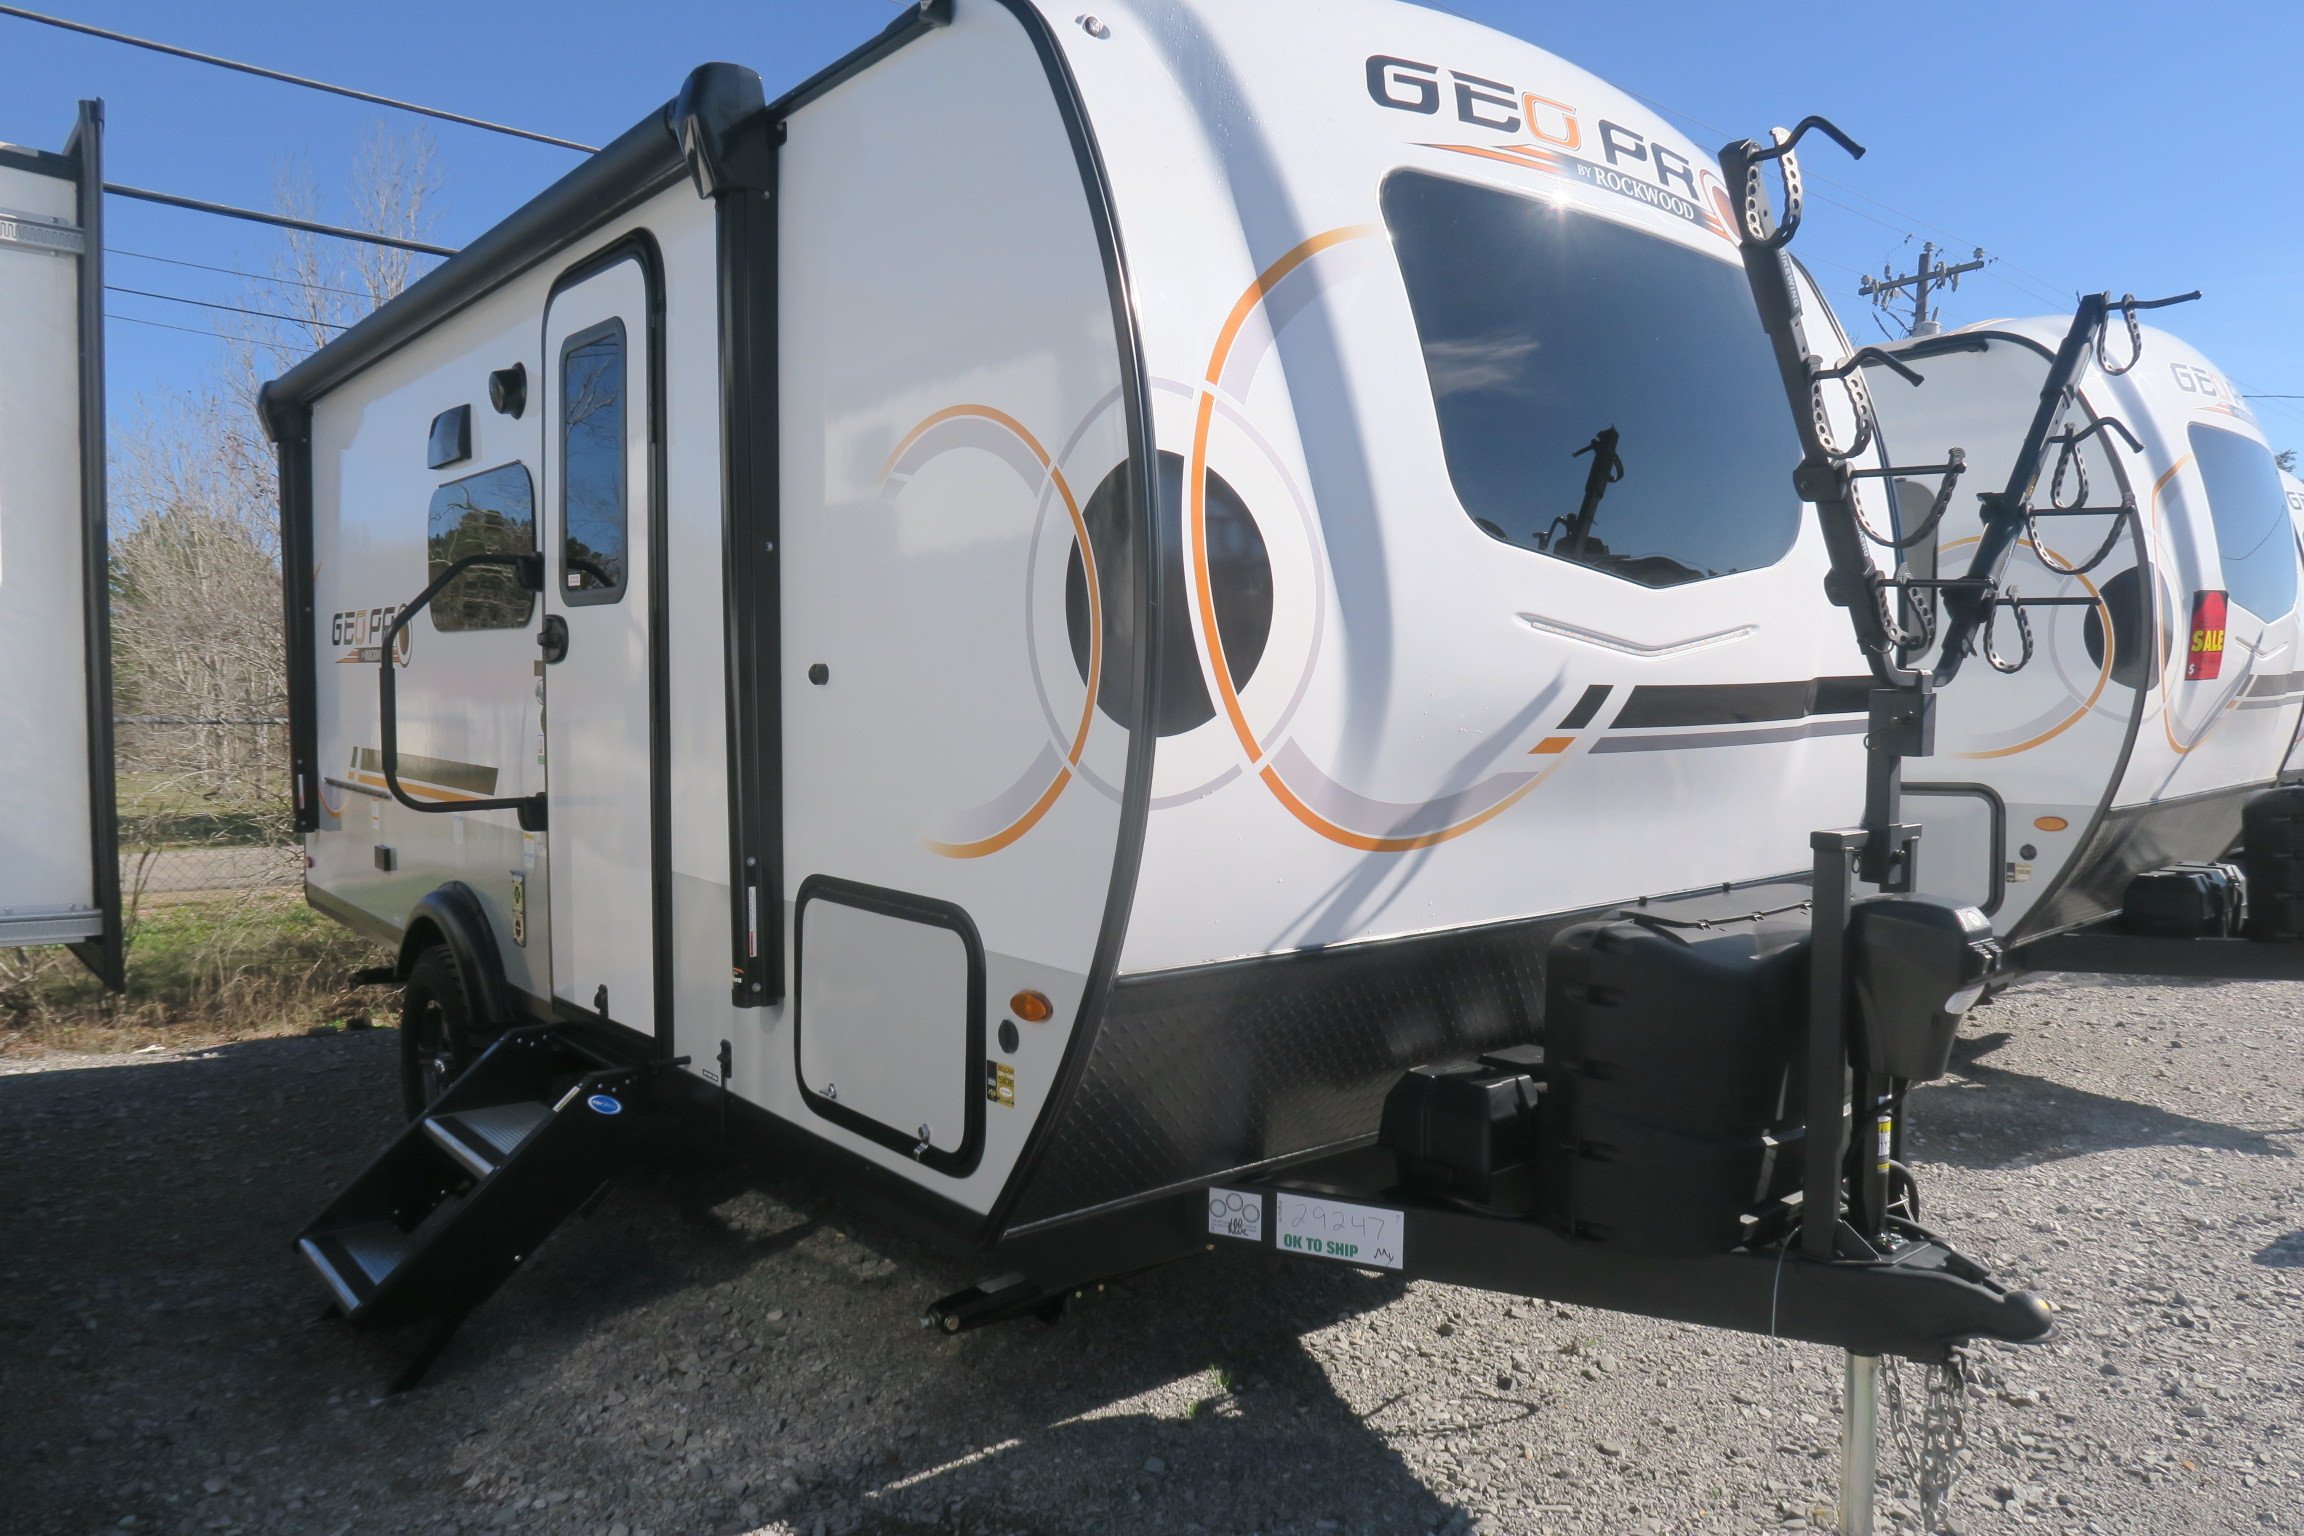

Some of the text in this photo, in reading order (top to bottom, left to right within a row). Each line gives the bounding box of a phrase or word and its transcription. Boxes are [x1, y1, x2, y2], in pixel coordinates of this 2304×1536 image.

[1365, 54, 1581, 151] GEO
[1577, 163, 1695, 221] BY ROCKWOOD
[332, 609, 368, 646] GEO
[2191, 629, 2225, 652] SALE
[1291, 1202, 1385, 1241] 29247
[1283, 1233, 1359, 1258] OK TO SHIP
